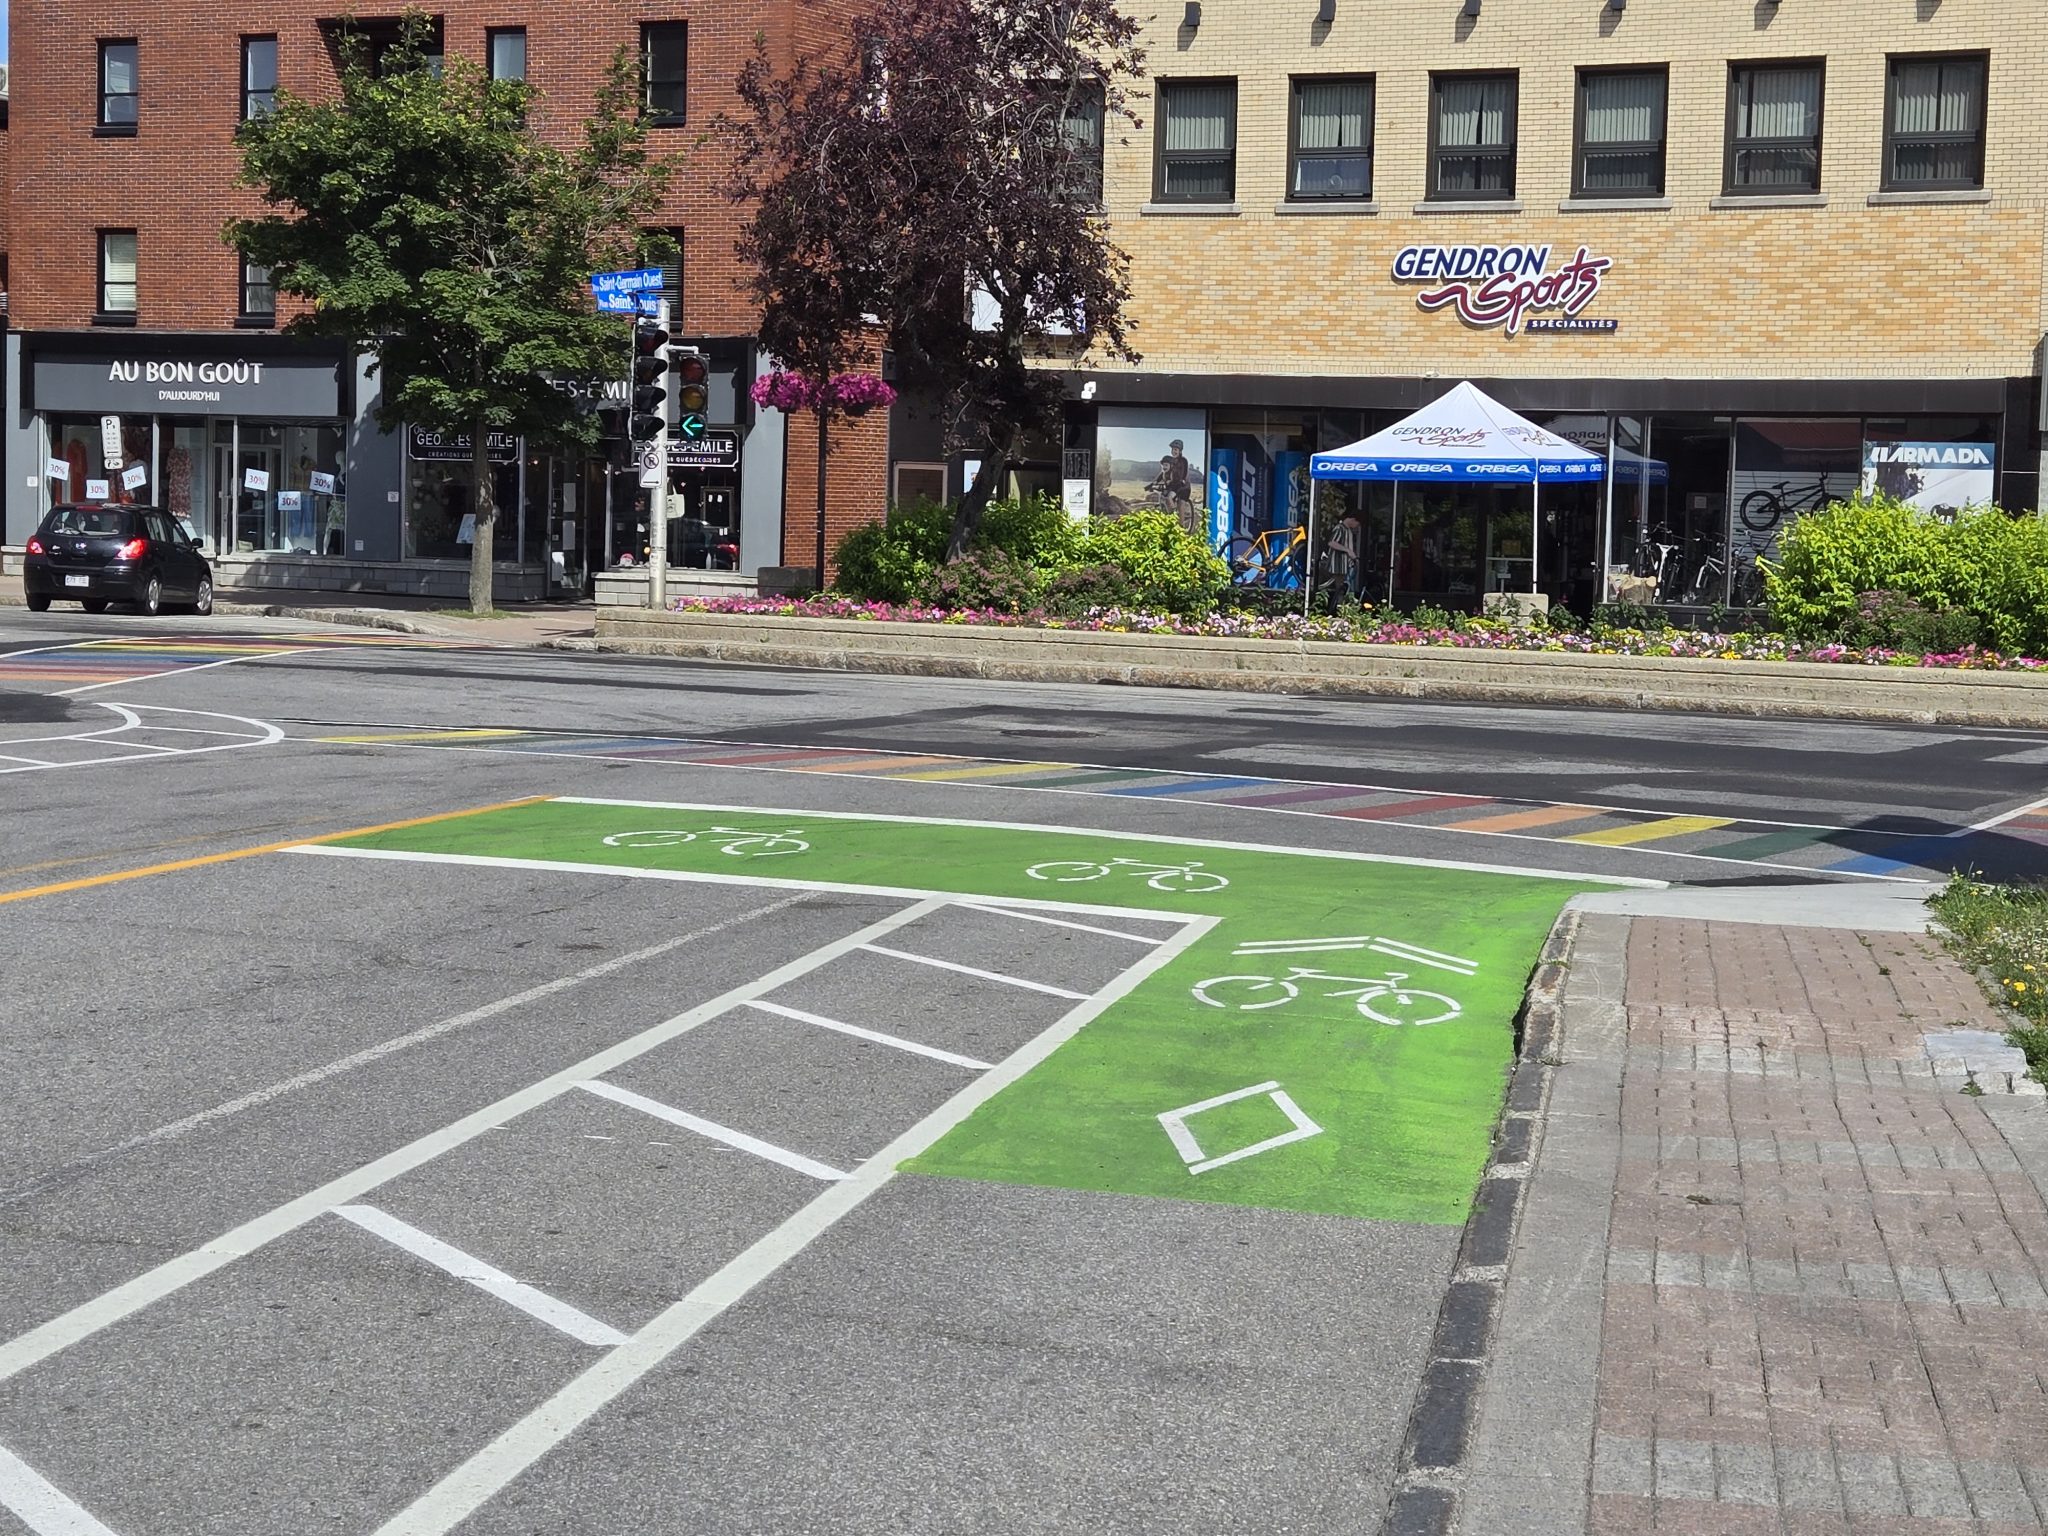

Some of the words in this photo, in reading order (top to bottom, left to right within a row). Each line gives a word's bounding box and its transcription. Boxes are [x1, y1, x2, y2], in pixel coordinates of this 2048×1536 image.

[1394, 247, 1549, 277] GENDRON
[599, 274, 643, 291] Saint-Germain
[643, 272, 662, 287] Ouest
[1420, 248, 1610, 331] Sports
[608, 294, 657, 311] Saint-ouis
[1531, 319, 1613, 328] SPÉCIALITÉS
[109, 360, 139, 382] AU
[146, 361, 193, 383] BON
[199, 358, 264, 384] GOÛT
[158, 390, 220, 401] D'AUJOURD'HUI
[1392, 427, 1465, 435] GENDRON
[1887, 447, 1990, 464] ARMADA
[50, 463, 65, 475] 30%
[1317, 462, 1378, 472] ORBEA
[1390, 463, 1453, 473] ORBEA
[1466, 464, 1530, 473] ORBEA
[127, 474, 142, 485] 30%
[250, 475, 265, 486] 30%
[314, 477, 330, 489] 30%
[90, 485, 105, 494] 30%
[1241, 451, 1255, 538] FELT
[282, 497, 298, 506] 30%
